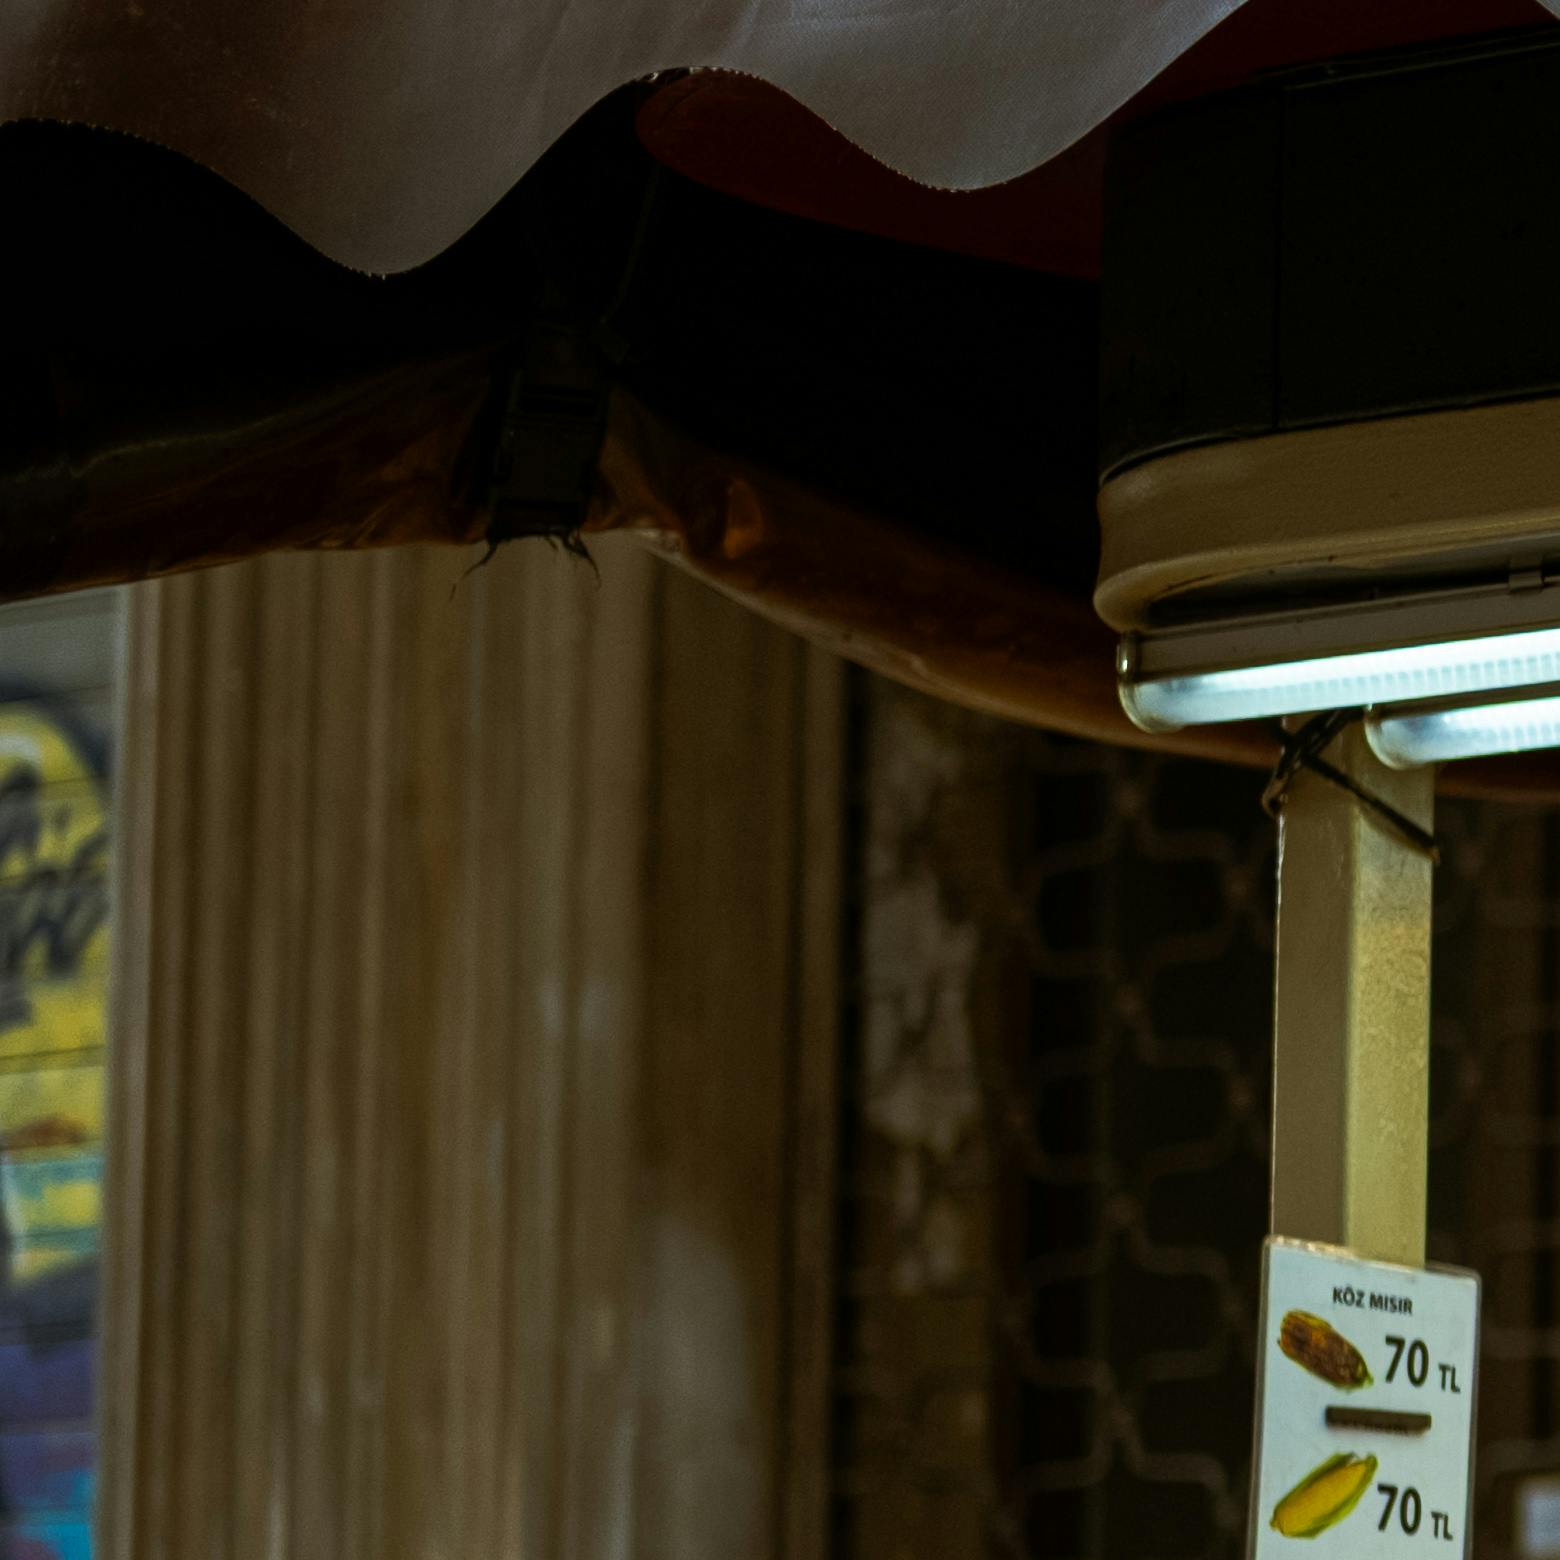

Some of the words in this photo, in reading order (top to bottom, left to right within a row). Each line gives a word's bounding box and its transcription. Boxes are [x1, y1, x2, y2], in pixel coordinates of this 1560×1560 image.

[1333, 1286, 1365, 1308] KÖZ
[1369, 1291, 1413, 1316] MISIR
[1385, 1334, 1429, 1388] 70
[1438, 1363, 1461, 1393] TL
[1377, 1483, 1422, 1536] 70
[1431, 1511, 1453, 1541] TL
